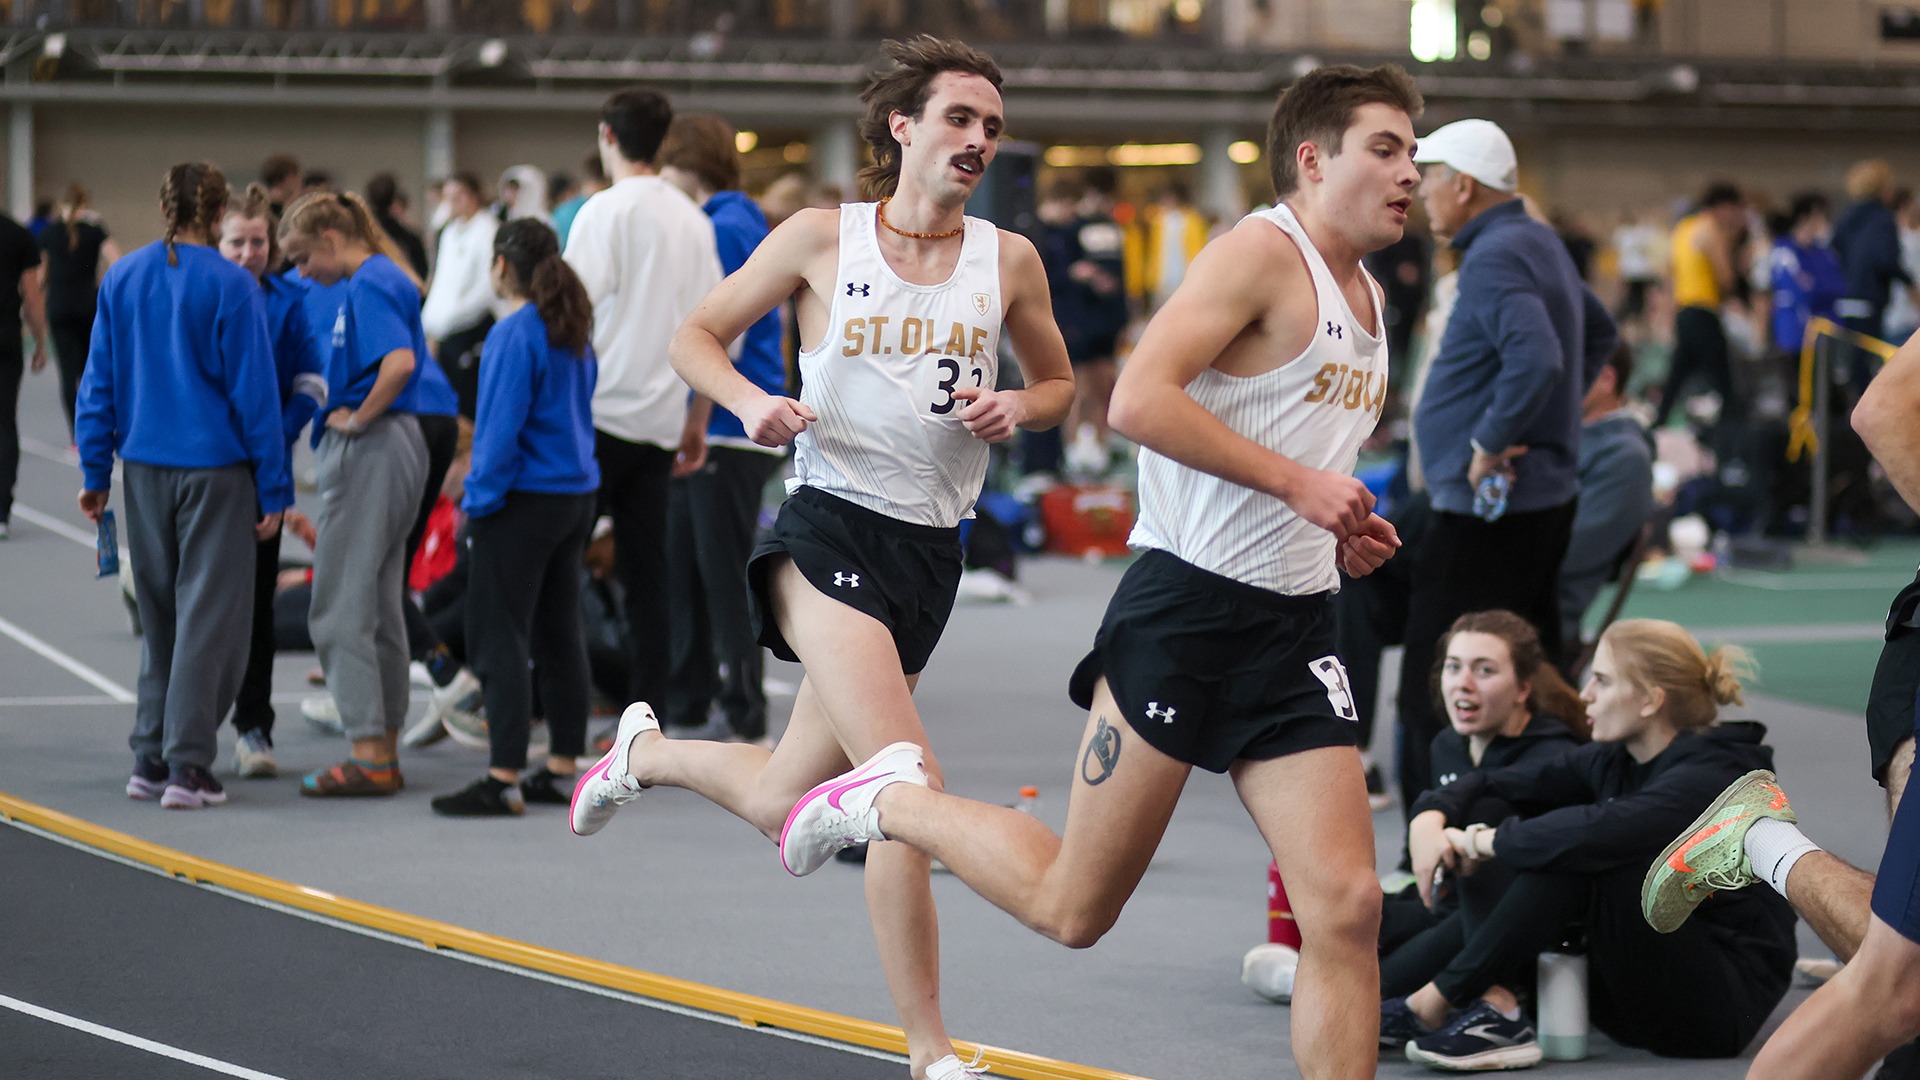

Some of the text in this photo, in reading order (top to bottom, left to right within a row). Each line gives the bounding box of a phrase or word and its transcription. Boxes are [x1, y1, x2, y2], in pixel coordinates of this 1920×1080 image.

[842, 316, 988, 365] ST. OLAF
[1343, 369, 1386, 422] OLA
[1319, 660, 1354, 718] 3
